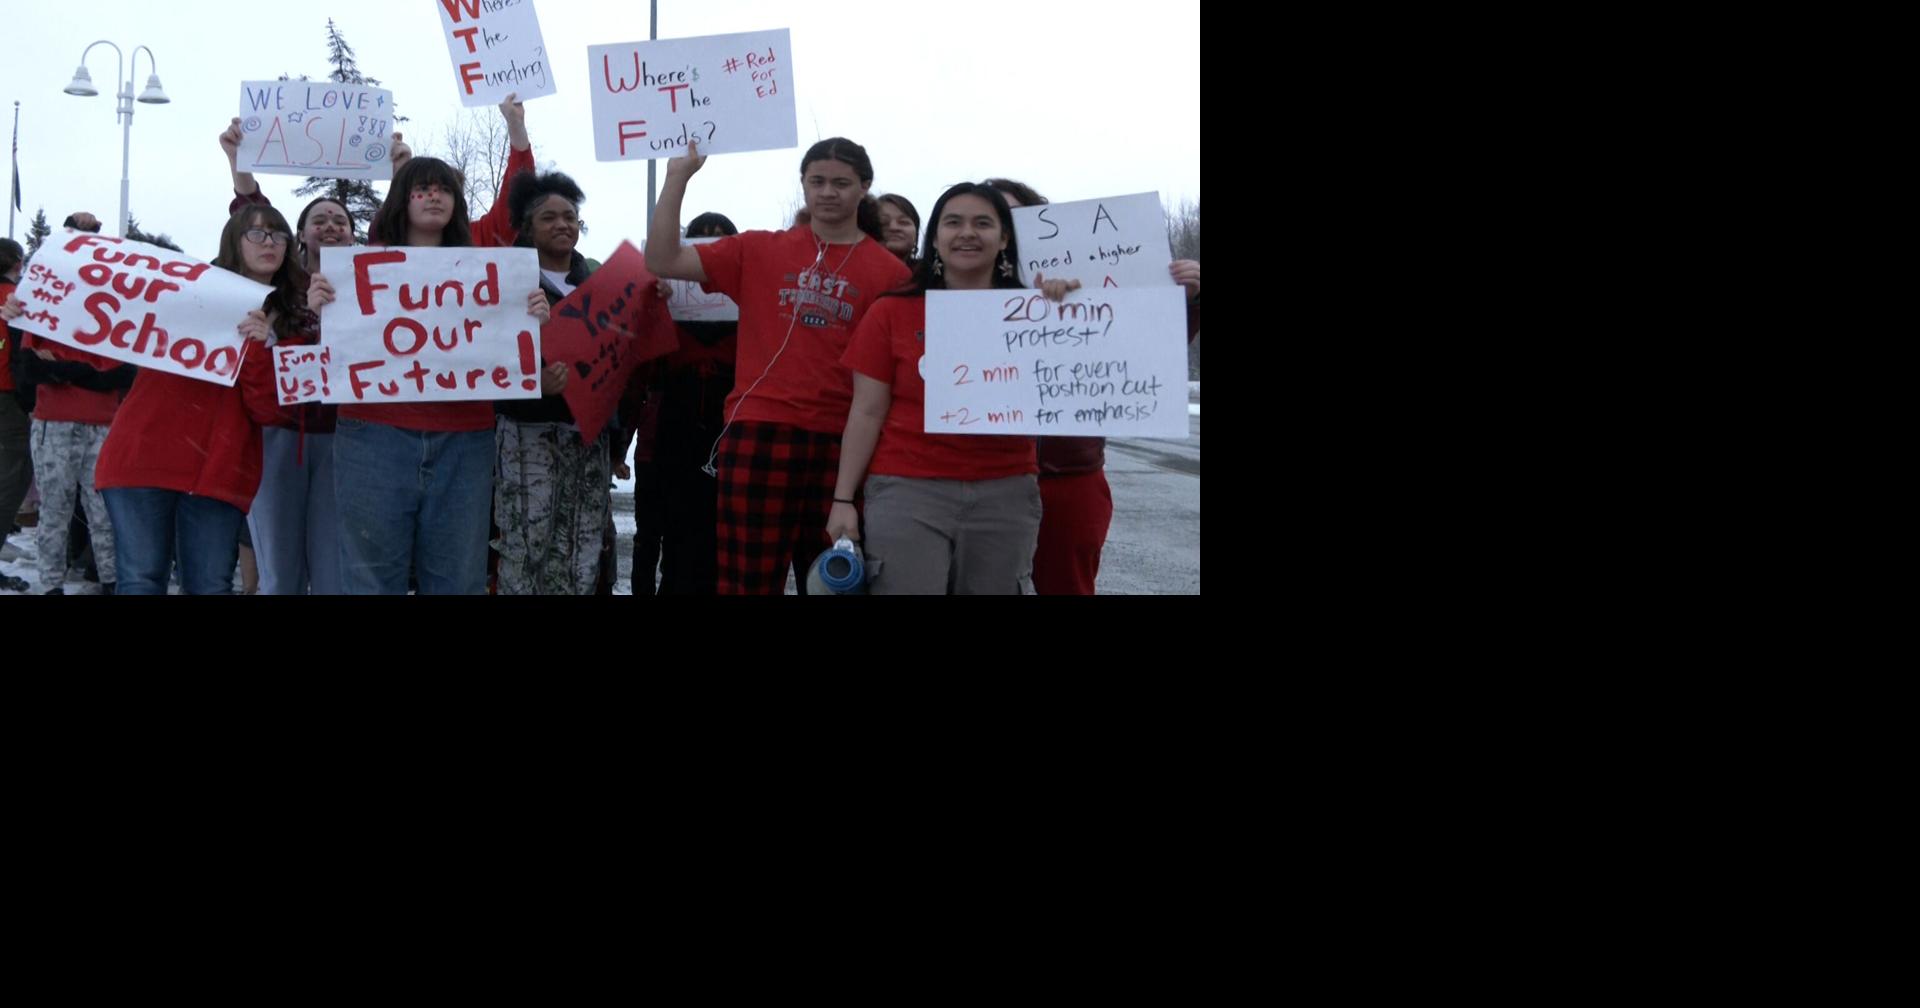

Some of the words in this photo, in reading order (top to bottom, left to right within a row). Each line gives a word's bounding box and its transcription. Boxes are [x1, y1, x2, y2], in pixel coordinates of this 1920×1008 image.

[452, 26, 509, 54] The
[603, 51, 701, 94] Where's
[722, 47, 776, 75] #Red
[246, 86, 286, 112] WE
[306, 87, 370, 111] LOVE
[657, 83, 711, 113] The
[755, 80, 777, 99] Ed
[618, 120, 716, 156] Funds?
[63, 234, 211, 281] Fund
[1029, 250, 1073, 271] need
[28, 264, 76, 297] Stop
[353, 250, 500, 315] Fund
[798, 271, 848, 298] EAST
[32, 288, 63, 305] the
[559, 282, 636, 338] Your
[1003, 295, 1049, 322] 20
[1057, 297, 1114, 323] min
[383, 316, 482, 357] Our
[279, 346, 331, 372] Fund
[348, 330, 537, 400] Future!
[953, 364, 974, 386] 2
[982, 363, 1020, 384] min
[1032, 359, 1062, 384] for
[1070, 360, 1128, 382] every
[1038, 381, 1115, 405] position
[1121, 375, 1162, 396] cut
[988, 405, 1024, 425] min
[1034, 405, 1061, 425] for
